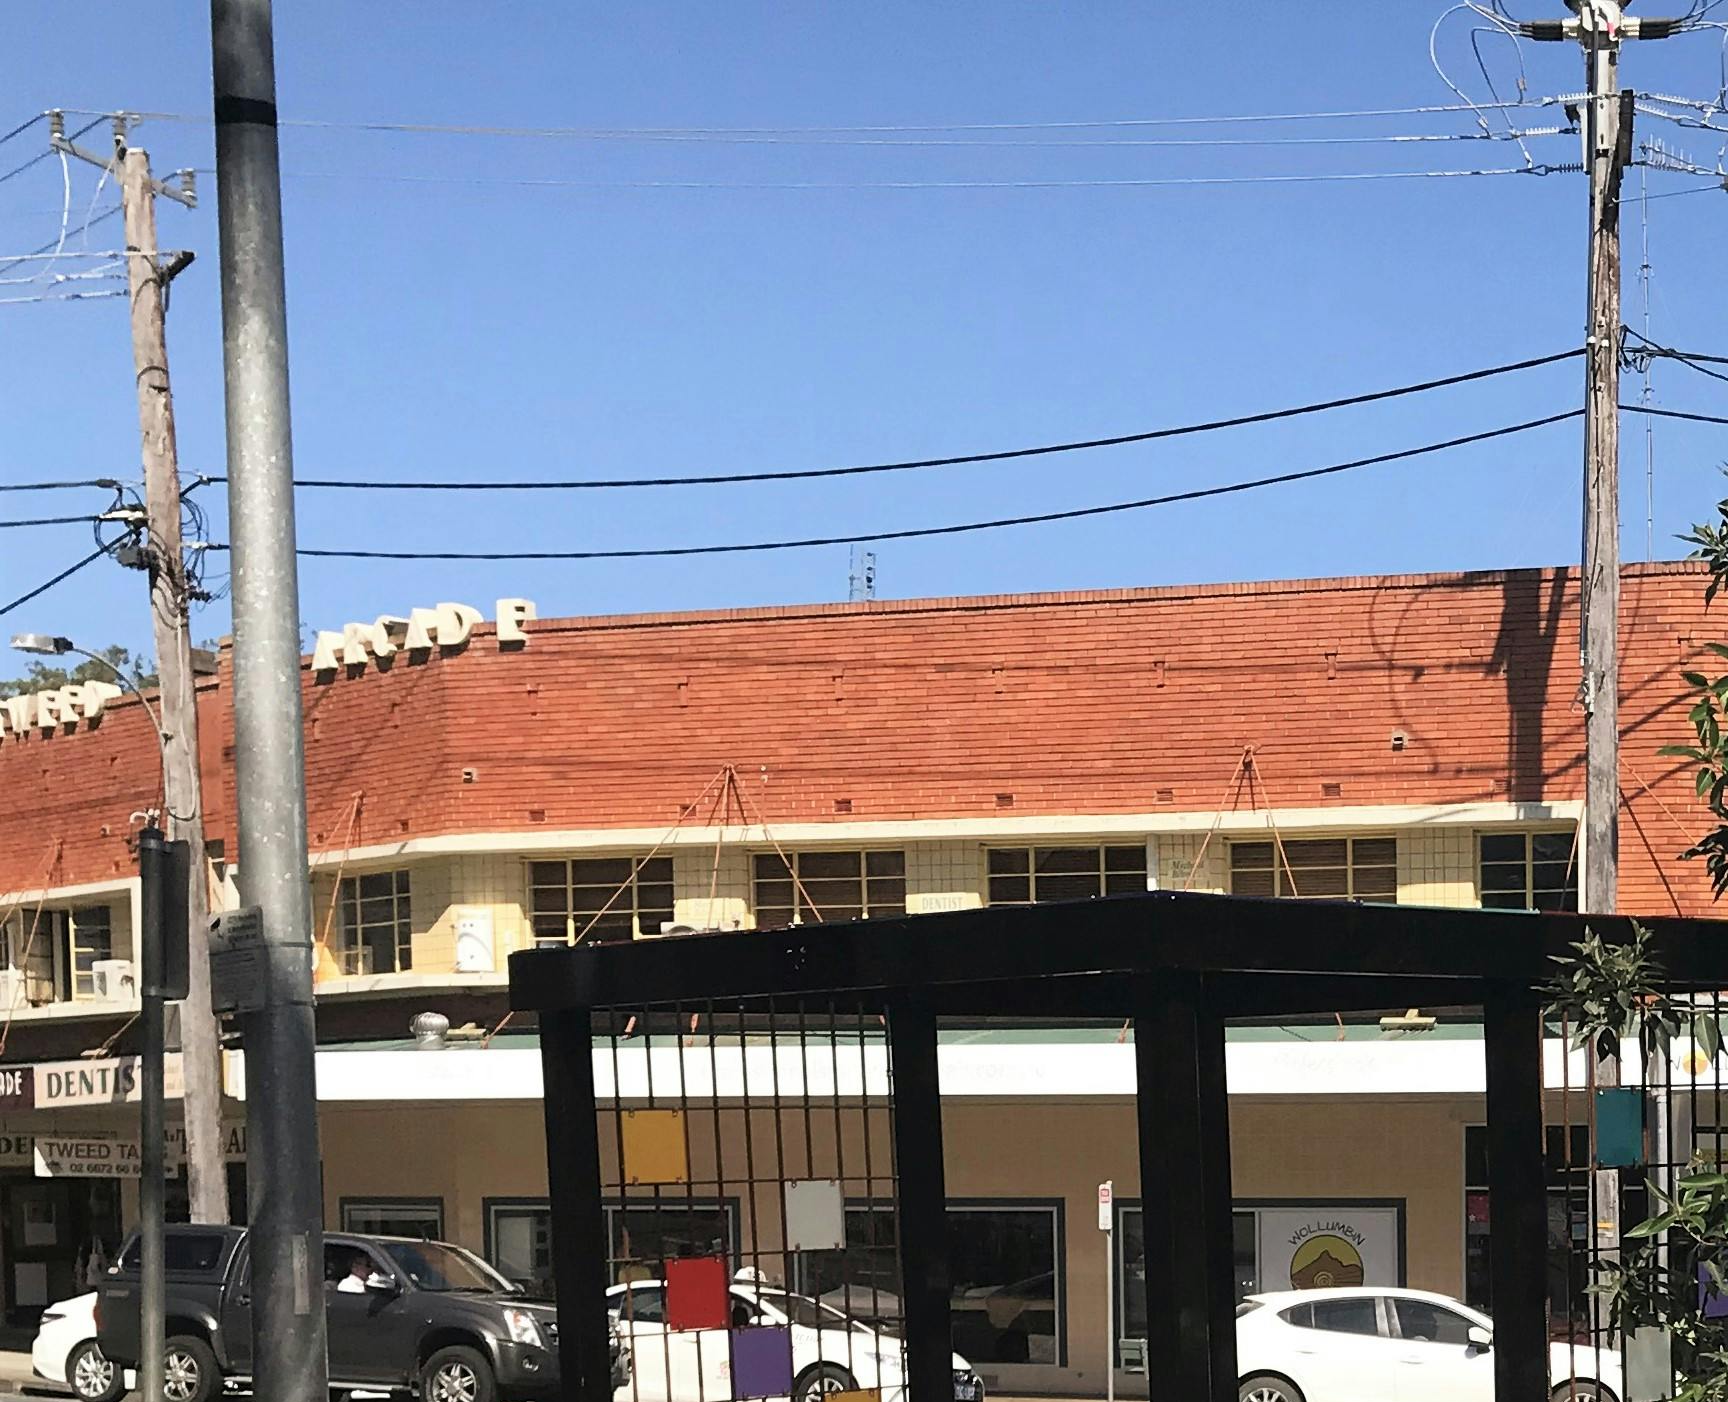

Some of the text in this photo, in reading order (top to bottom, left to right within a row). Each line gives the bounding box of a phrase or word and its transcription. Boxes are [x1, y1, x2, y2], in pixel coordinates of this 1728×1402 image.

[311, 598, 536, 670] ARCADE
[922, 896, 962, 910] DENTIST
[47, 1064, 142, 1099] DENTIS
[44, 1142, 111, 1159] TWEED
[1288, 1221, 1366, 1247] WOLLUMBIN
